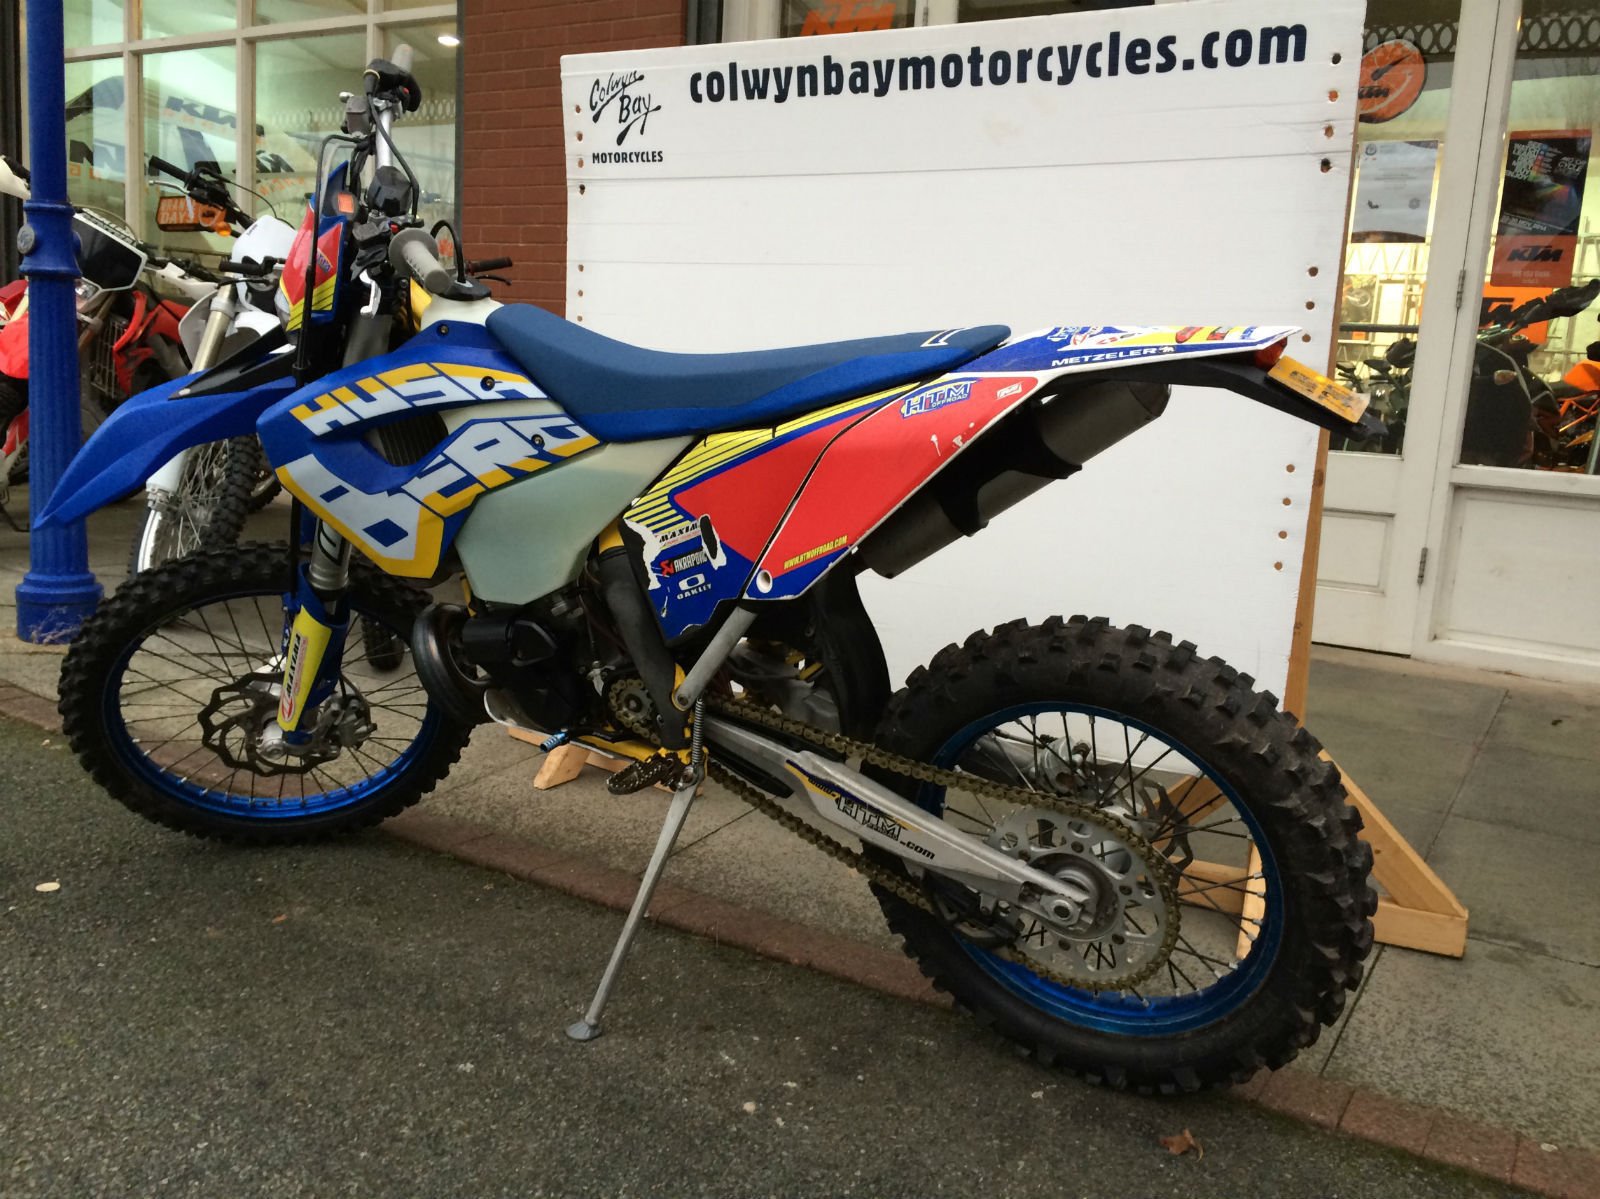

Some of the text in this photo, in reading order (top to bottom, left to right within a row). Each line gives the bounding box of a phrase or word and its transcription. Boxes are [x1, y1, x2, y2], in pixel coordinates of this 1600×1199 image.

[690, 23, 1308, 104] colwynbaymotorcycles.com
[589, 70, 644, 115] Colwyn
[592, 150, 664, 164] MOTORCYCLES
[1507, 245, 1564, 262] KTM
[1051, 347, 1157, 367] METZELER
[903, 382, 972, 418] HTM
[931, 393, 968, 408] OFFROAD
[676, 583, 712, 600] OAKLEY
